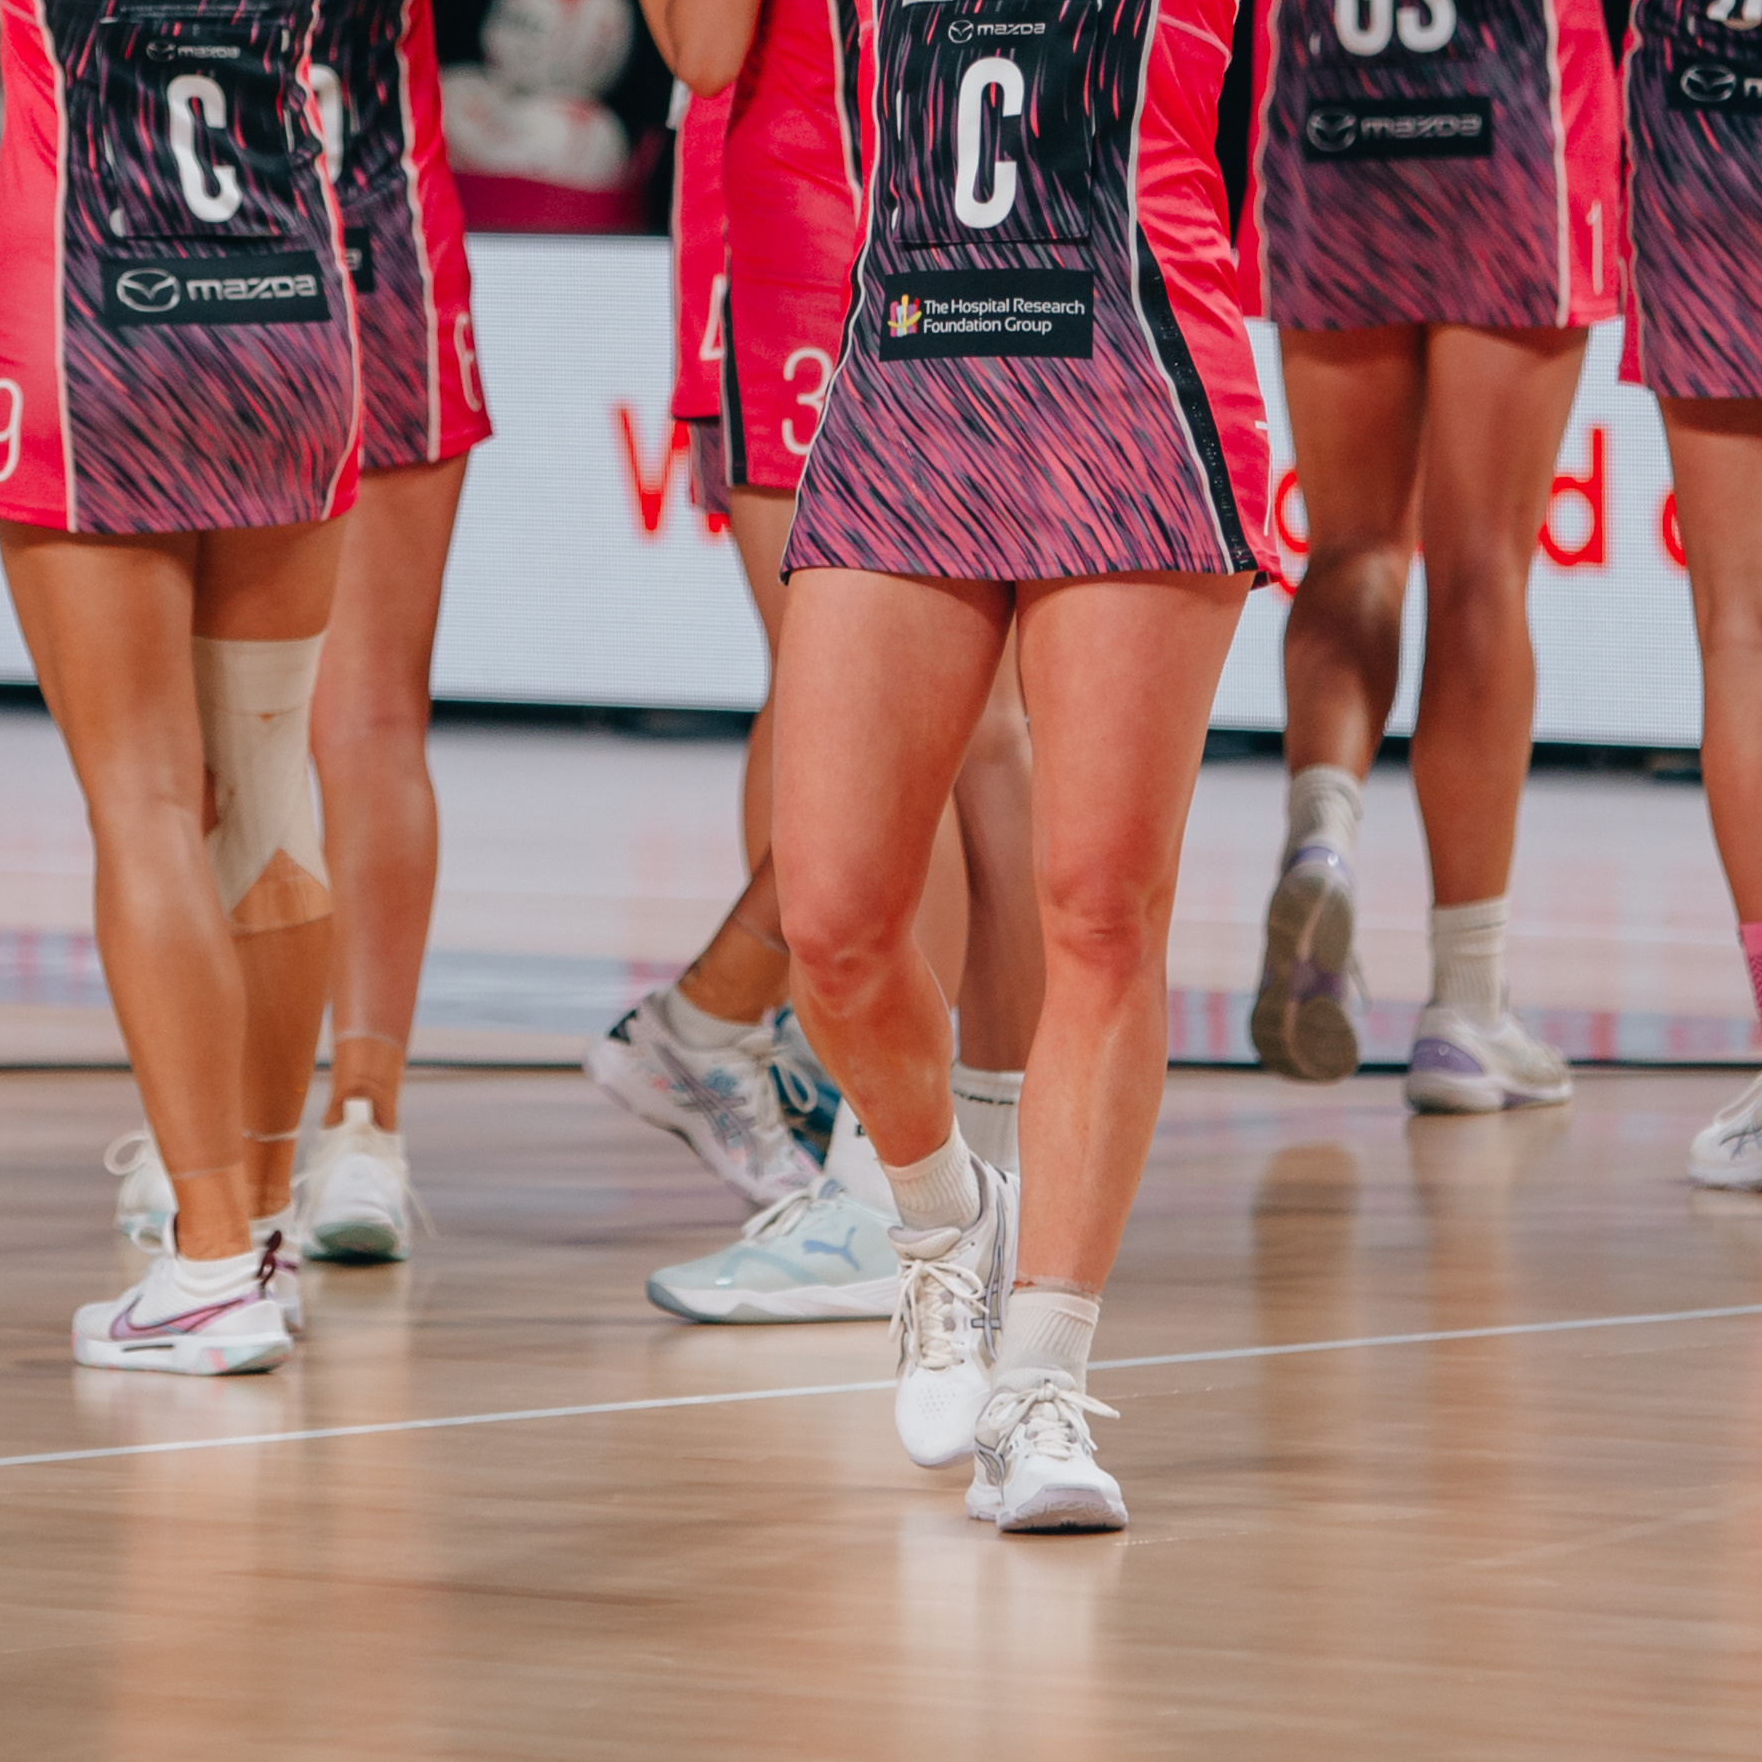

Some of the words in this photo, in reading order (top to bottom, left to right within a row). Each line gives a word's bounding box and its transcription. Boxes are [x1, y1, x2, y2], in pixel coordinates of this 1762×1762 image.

[976, 23, 1046, 36] mazda
[167, 75, 243, 223] C
[955, 56, 1025, 229] C
[186, 274, 318, 301] mazda
[924, 300, 949, 314] The
[951, 298, 1010, 316] Hospital
[1012, 297, 1085, 315] Research
[923, 318, 1001, 334] Foundation
[1004, 316, 1053, 336] Group
[781, 346, 835, 456] 3
